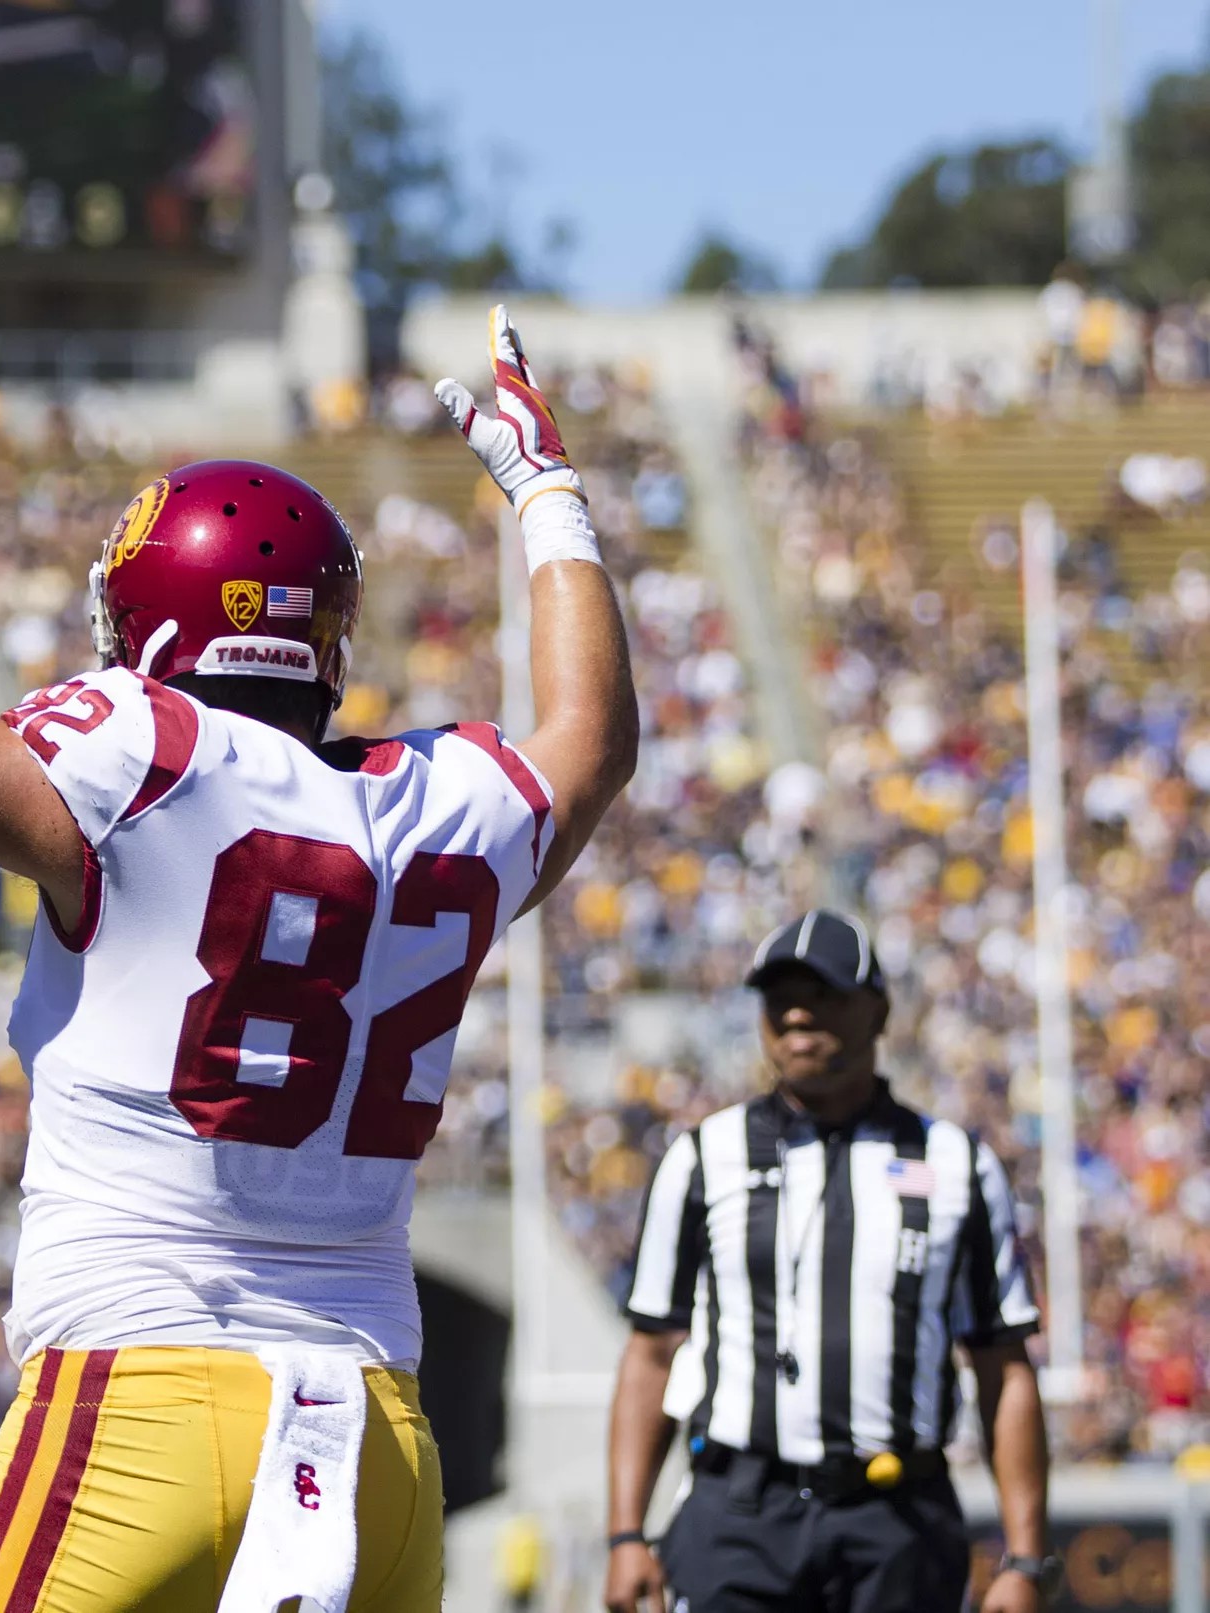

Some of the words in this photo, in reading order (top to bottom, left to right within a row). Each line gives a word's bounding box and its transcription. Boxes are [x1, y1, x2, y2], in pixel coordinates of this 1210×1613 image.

[223, 583, 260, 610] PAC
[233, 602, 253, 620] 12
[216, 647, 310, 670] TROJANS
[168, 828, 500, 1160] 82
